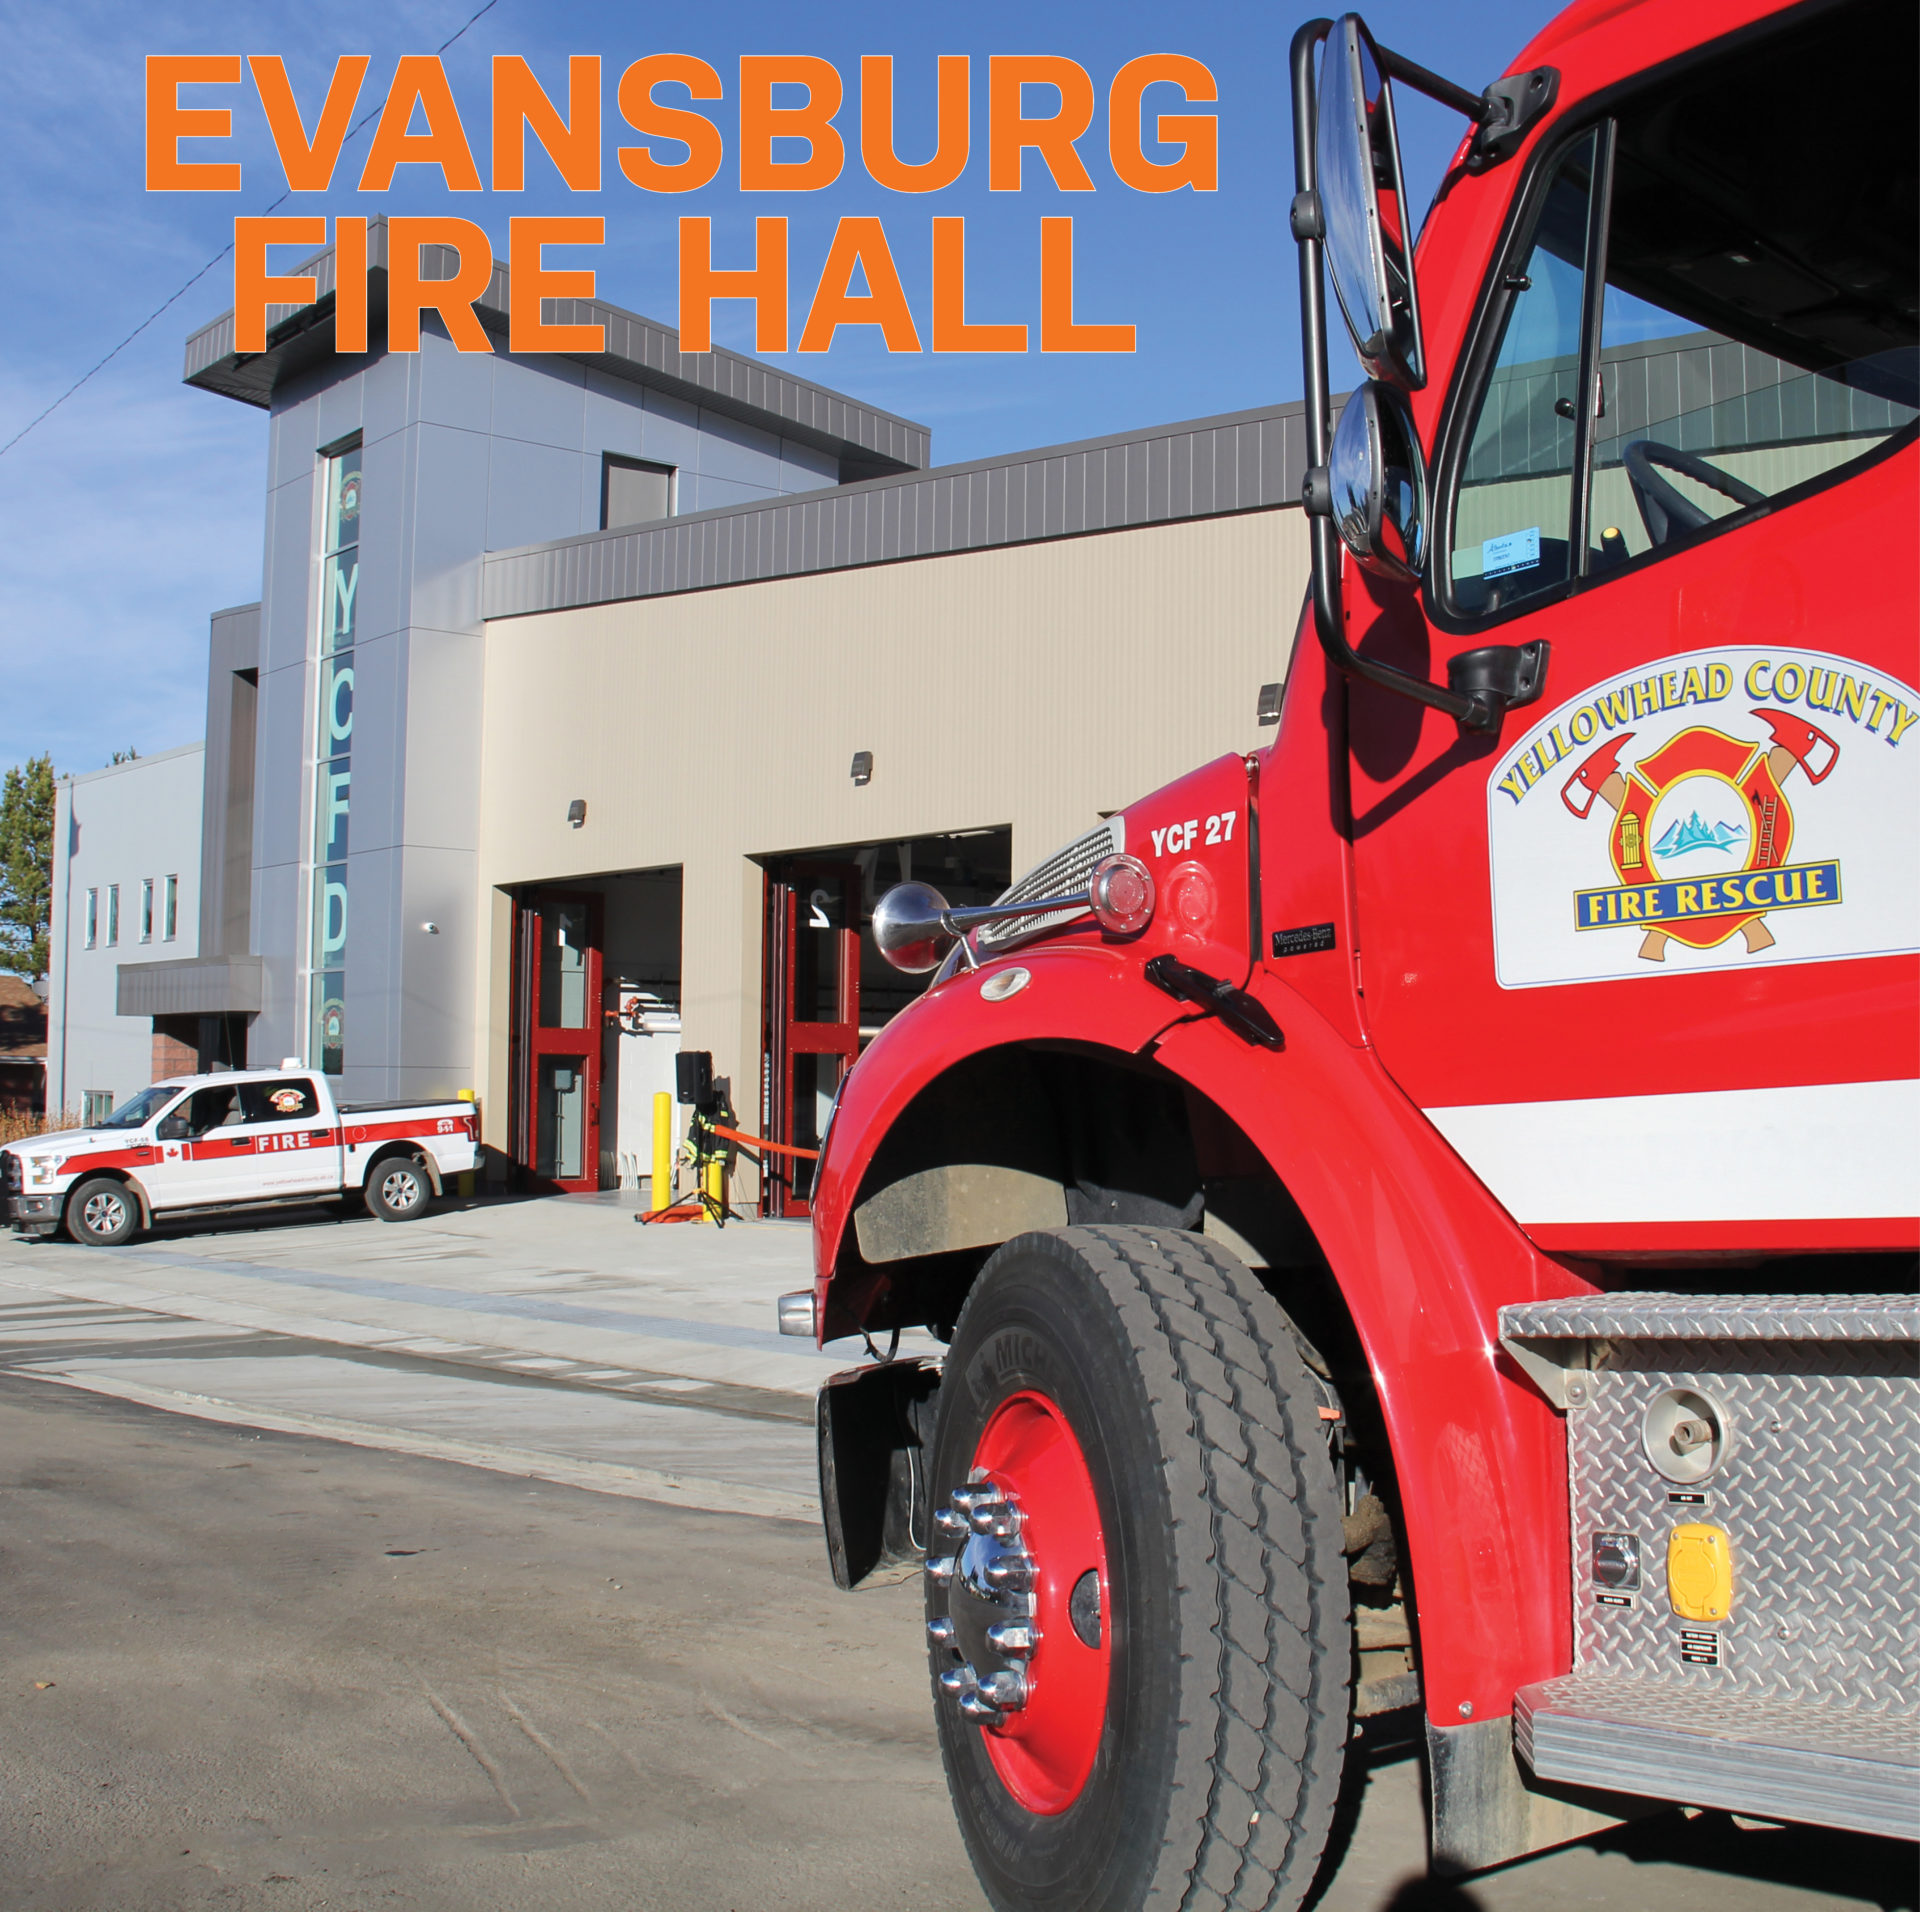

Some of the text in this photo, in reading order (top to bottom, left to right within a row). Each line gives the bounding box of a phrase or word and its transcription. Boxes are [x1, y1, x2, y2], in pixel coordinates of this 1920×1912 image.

[1497, 660, 1919, 805] YELLOWHEAD COUNTY
[1151, 810, 1237, 857] YCF 27
[1588, 869, 1828, 923] FIRE RESCUE
[1274, 927, 1332, 946] Mercedes-Benz
[258, 1132, 311, 1152] FIRE
